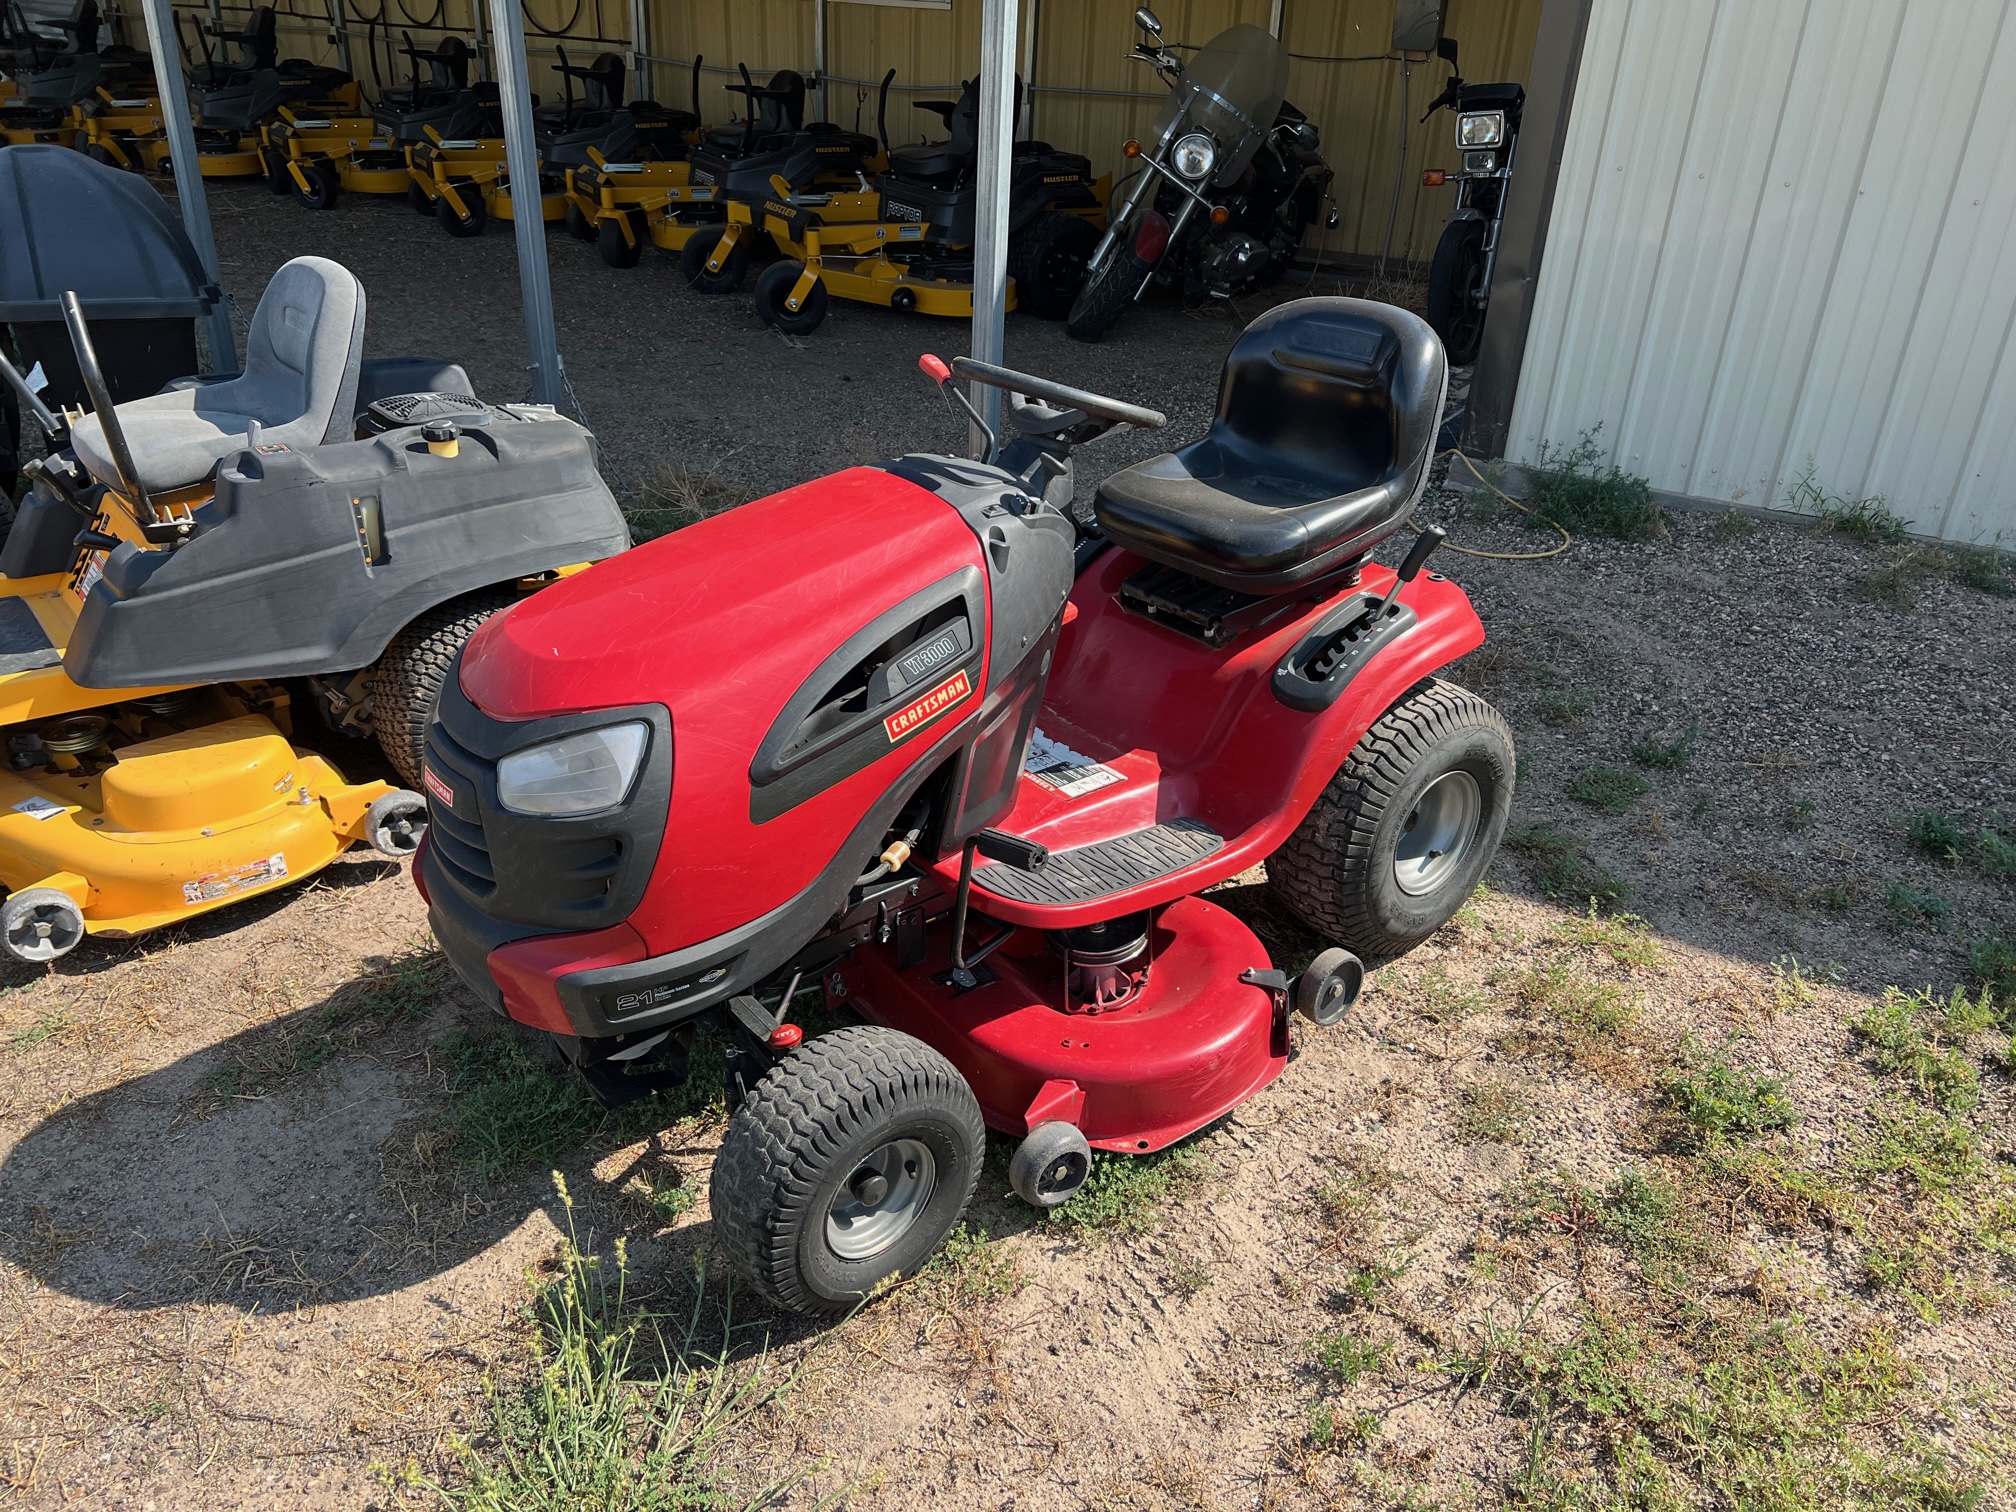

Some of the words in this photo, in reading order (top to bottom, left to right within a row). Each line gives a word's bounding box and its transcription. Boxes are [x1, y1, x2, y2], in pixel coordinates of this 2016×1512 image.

[634, 121, 669, 129] HUSTLER
[1043, 174, 1079, 184] HUSTLER
[763, 200, 798, 219] HUSTLER
[886, 200, 923, 223] RAPTOR
[904, 638, 956, 675] YT3000
[891, 676, 966, 733] CRAFTSMAN
[617, 990, 653, 1011] 21
